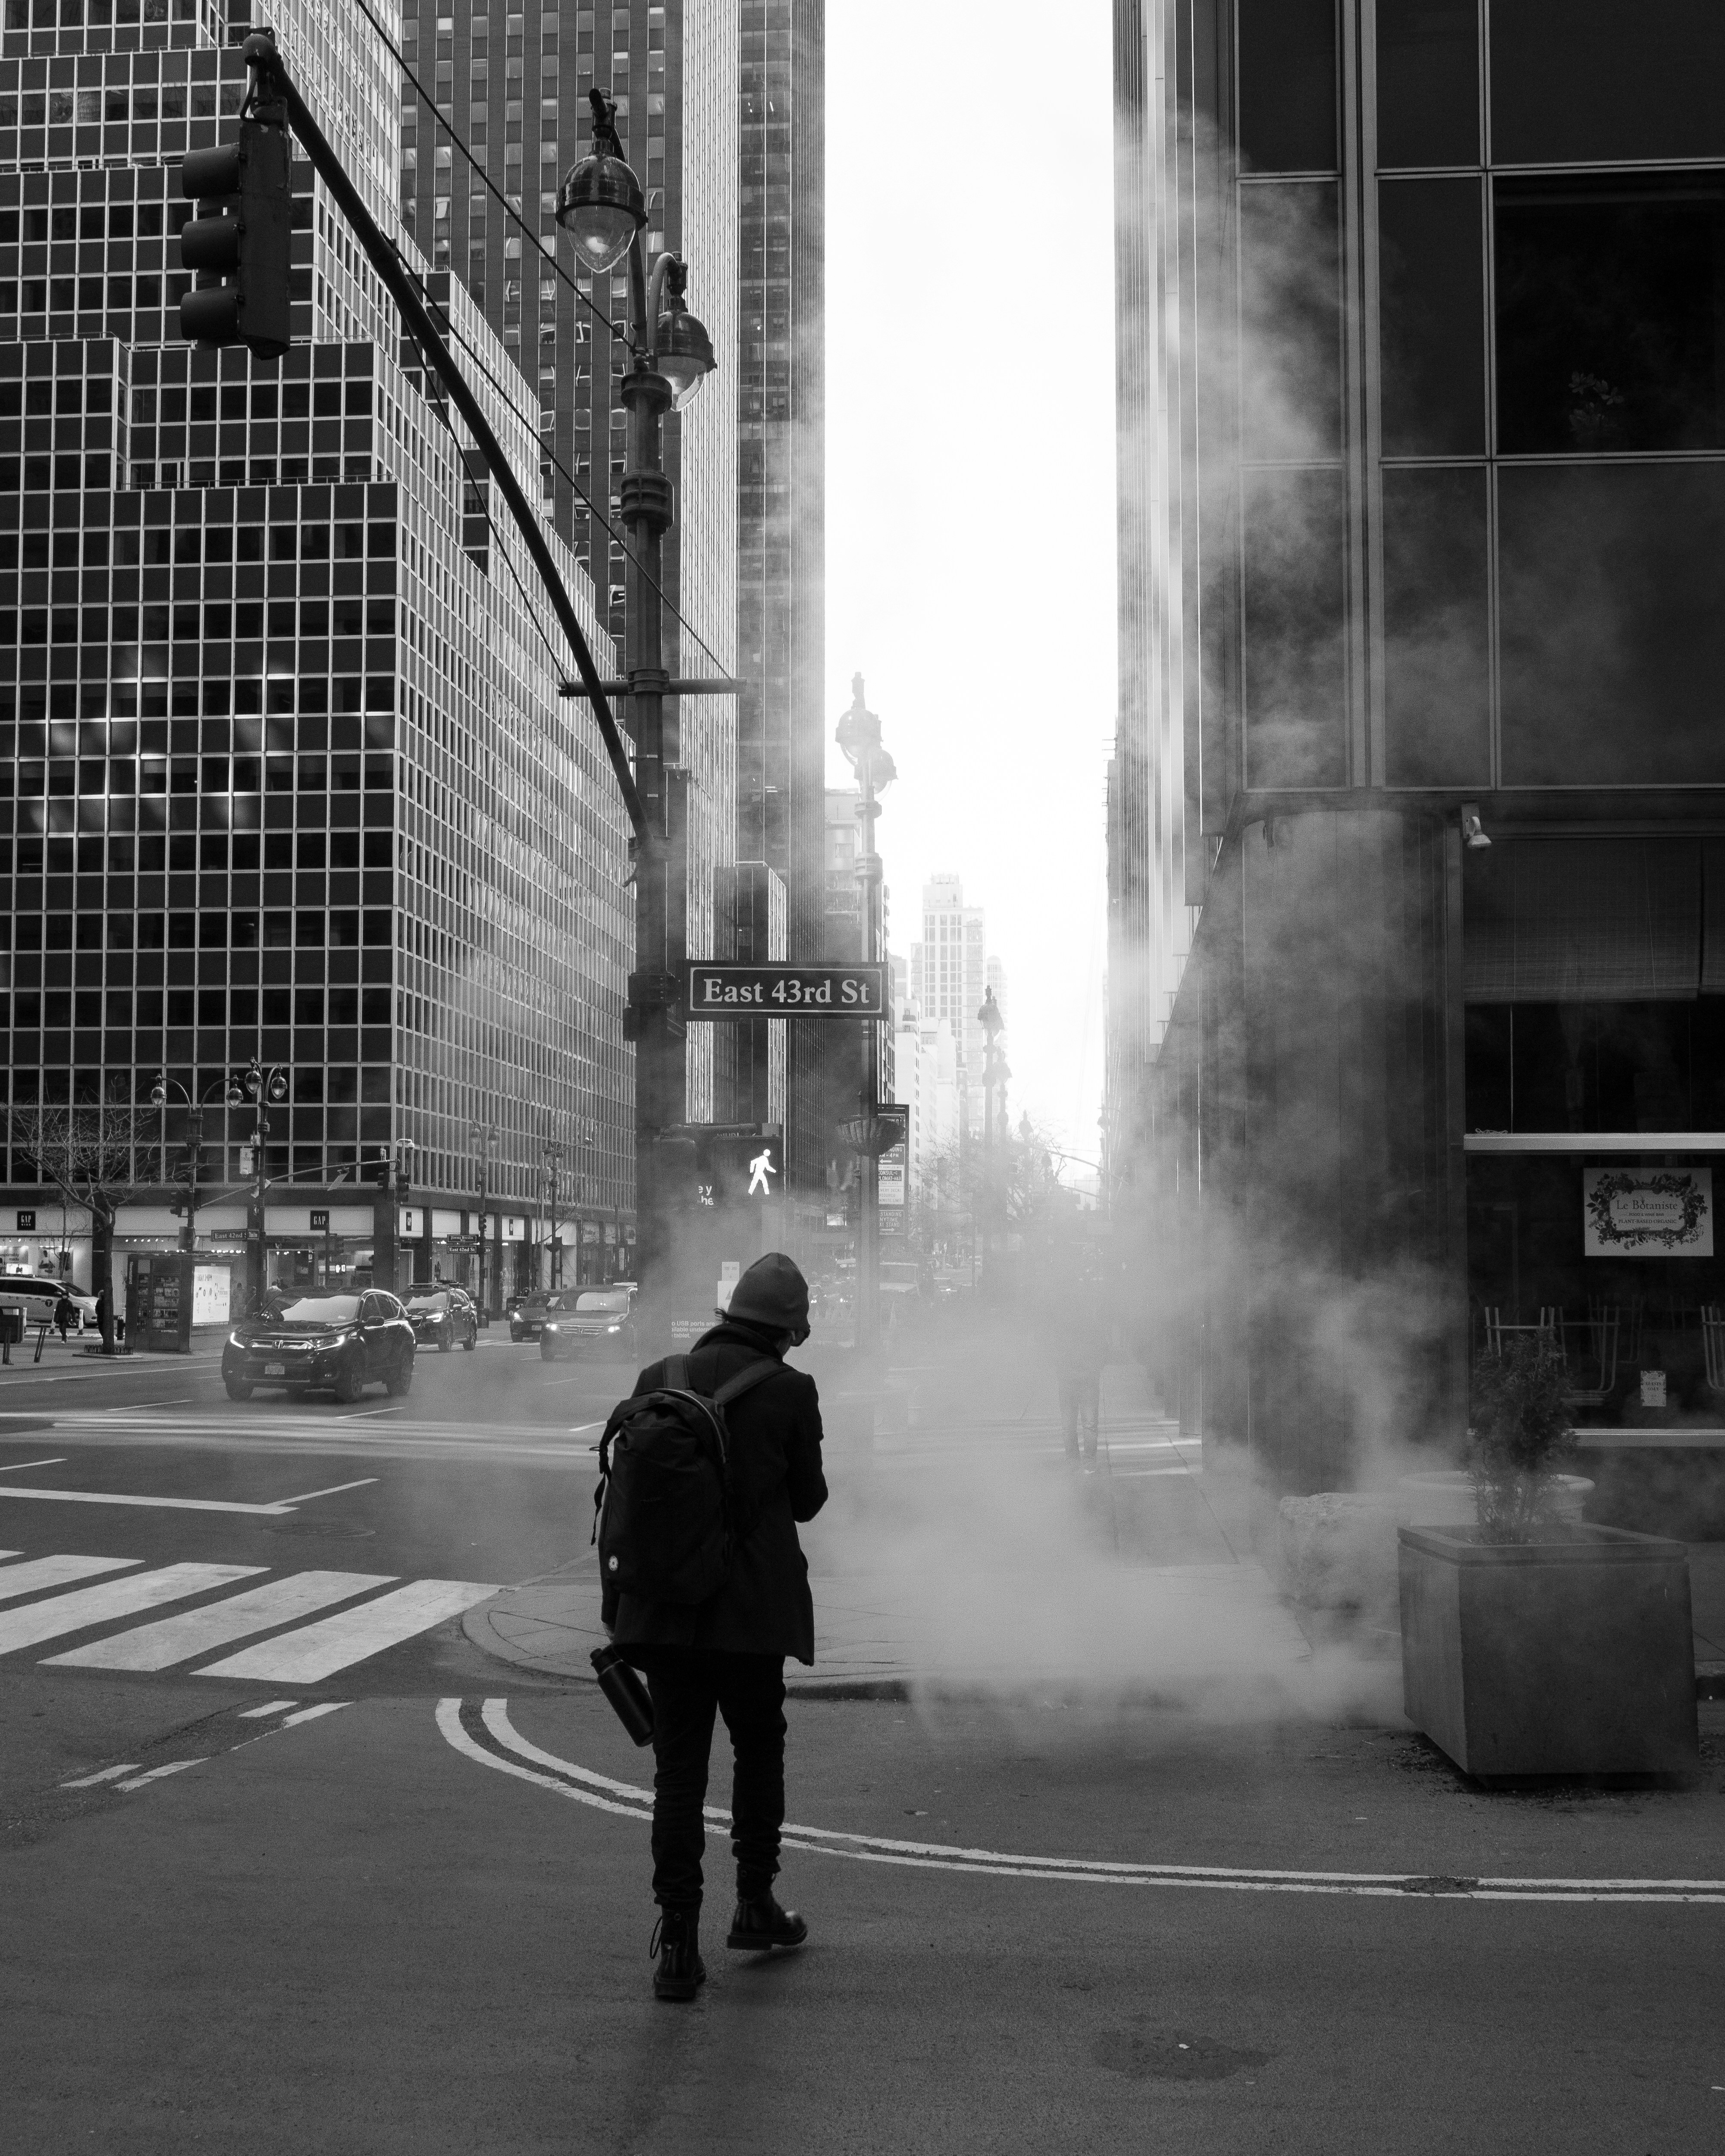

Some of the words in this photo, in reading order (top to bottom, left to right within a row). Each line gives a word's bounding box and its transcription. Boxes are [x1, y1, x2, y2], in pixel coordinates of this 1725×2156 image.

[703, 978, 763, 1003] East
[771, 978, 831, 1003] 43rd
[841, 979, 869, 1003] St
[1616, 1200, 1628, 1210] Le
[1633, 1200, 1678, 1210] Botaniste
[314, 1216, 326, 1225] GAP
